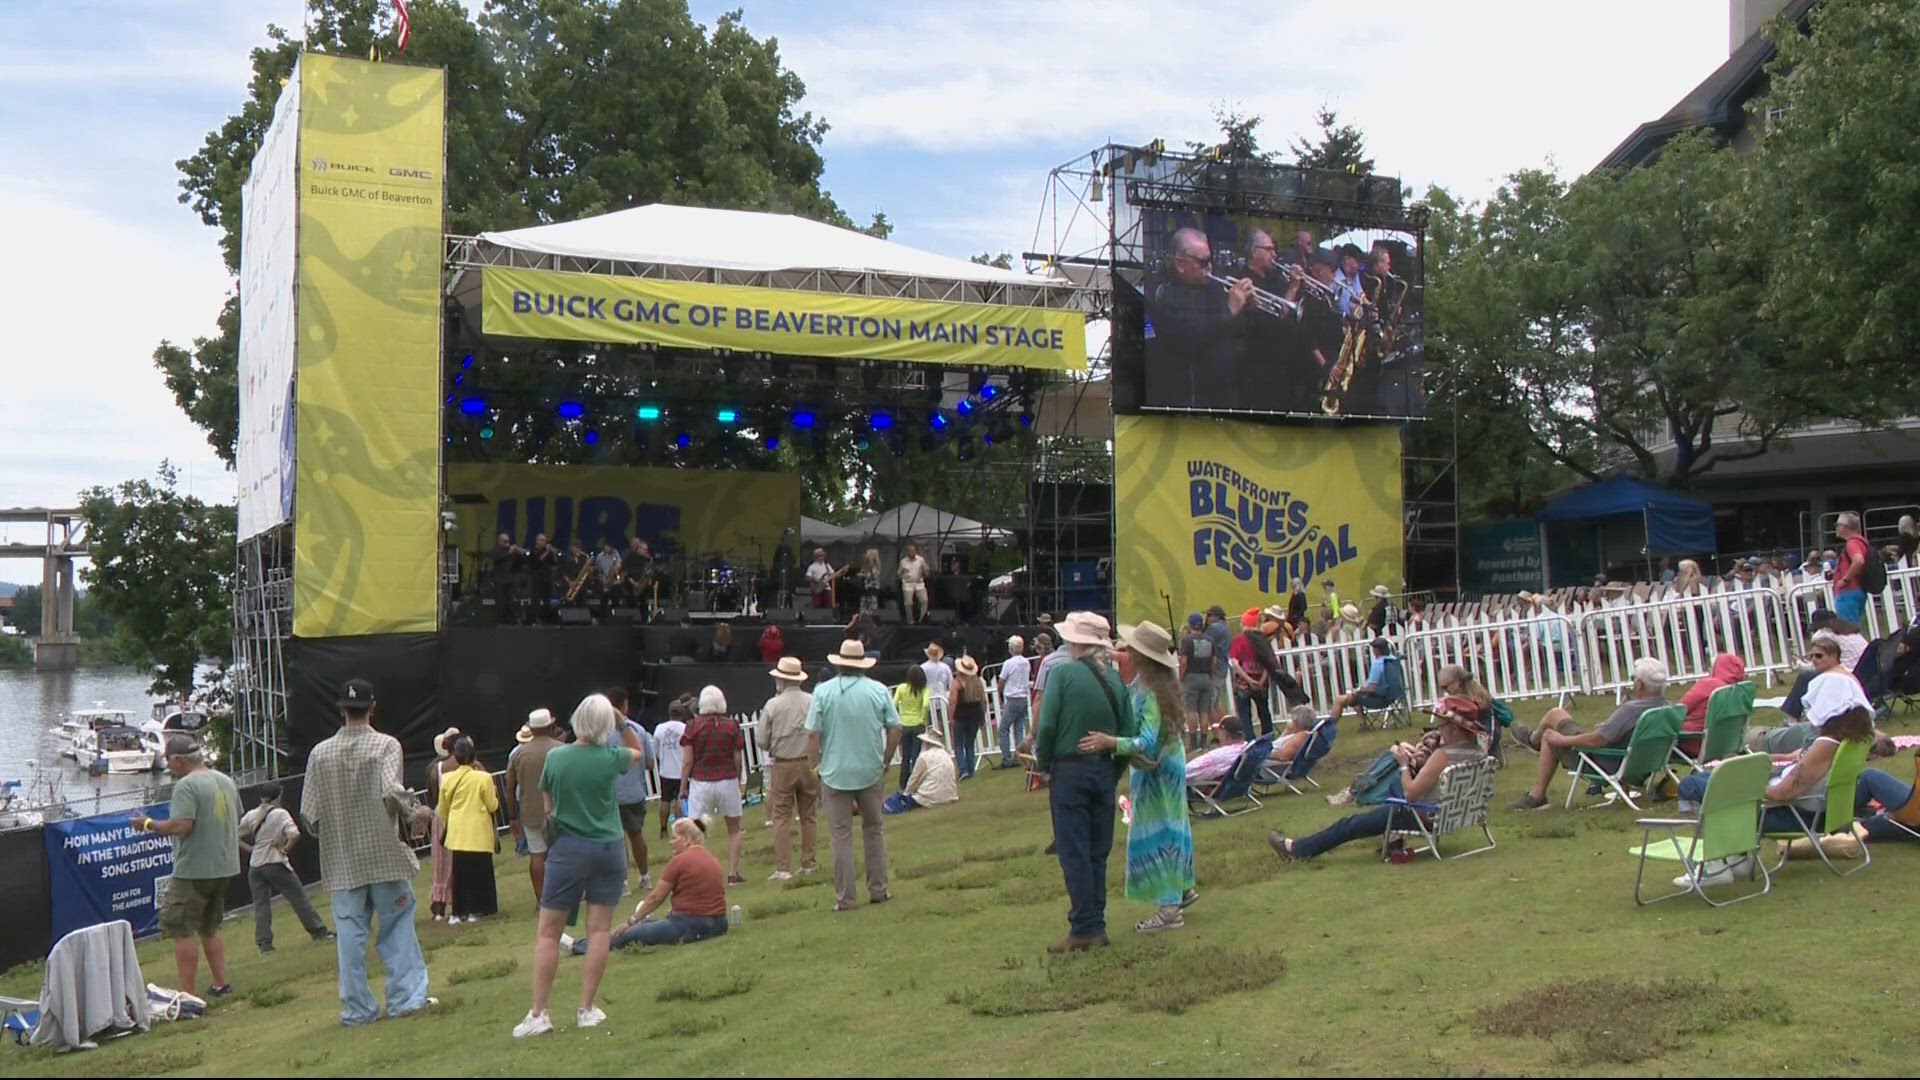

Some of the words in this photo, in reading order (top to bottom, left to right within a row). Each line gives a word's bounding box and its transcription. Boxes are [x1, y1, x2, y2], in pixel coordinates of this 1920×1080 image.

[330, 162, 375, 173] BUICK
[389, 168, 432, 180] GMC
[311, 185, 339, 196] Buick
[341, 187, 366, 199] GMC
[368, 190, 379, 200] of
[382, 191, 432, 205] Beaverton
[513, 290, 606, 320] BUICK
[614, 299, 680, 325] GMC
[688, 305, 727, 328] OF
[736, 308, 900, 341] BEAVERTON
[910, 319, 978, 344] MAIN
[985, 325, 1064, 350] STAGE
[1187, 460, 1291, 506] WATERFRONT
[1190, 479, 1309, 543] BLUES
[1193, 523, 1357, 594] FESTIVAL
[64, 834, 89, 848] HOW
[91, 828, 123, 844] MANY
[124, 826, 145, 839] BA
[78, 851, 91, 865] IN
[91, 848, 113, 862] THE
[114, 835, 173, 859] TRADITIONAL
[101, 861, 130, 878] SONG
[112, 890, 129, 901] SCAN
[130, 887, 141, 897] FOR
[112, 901, 126, 912] THE
